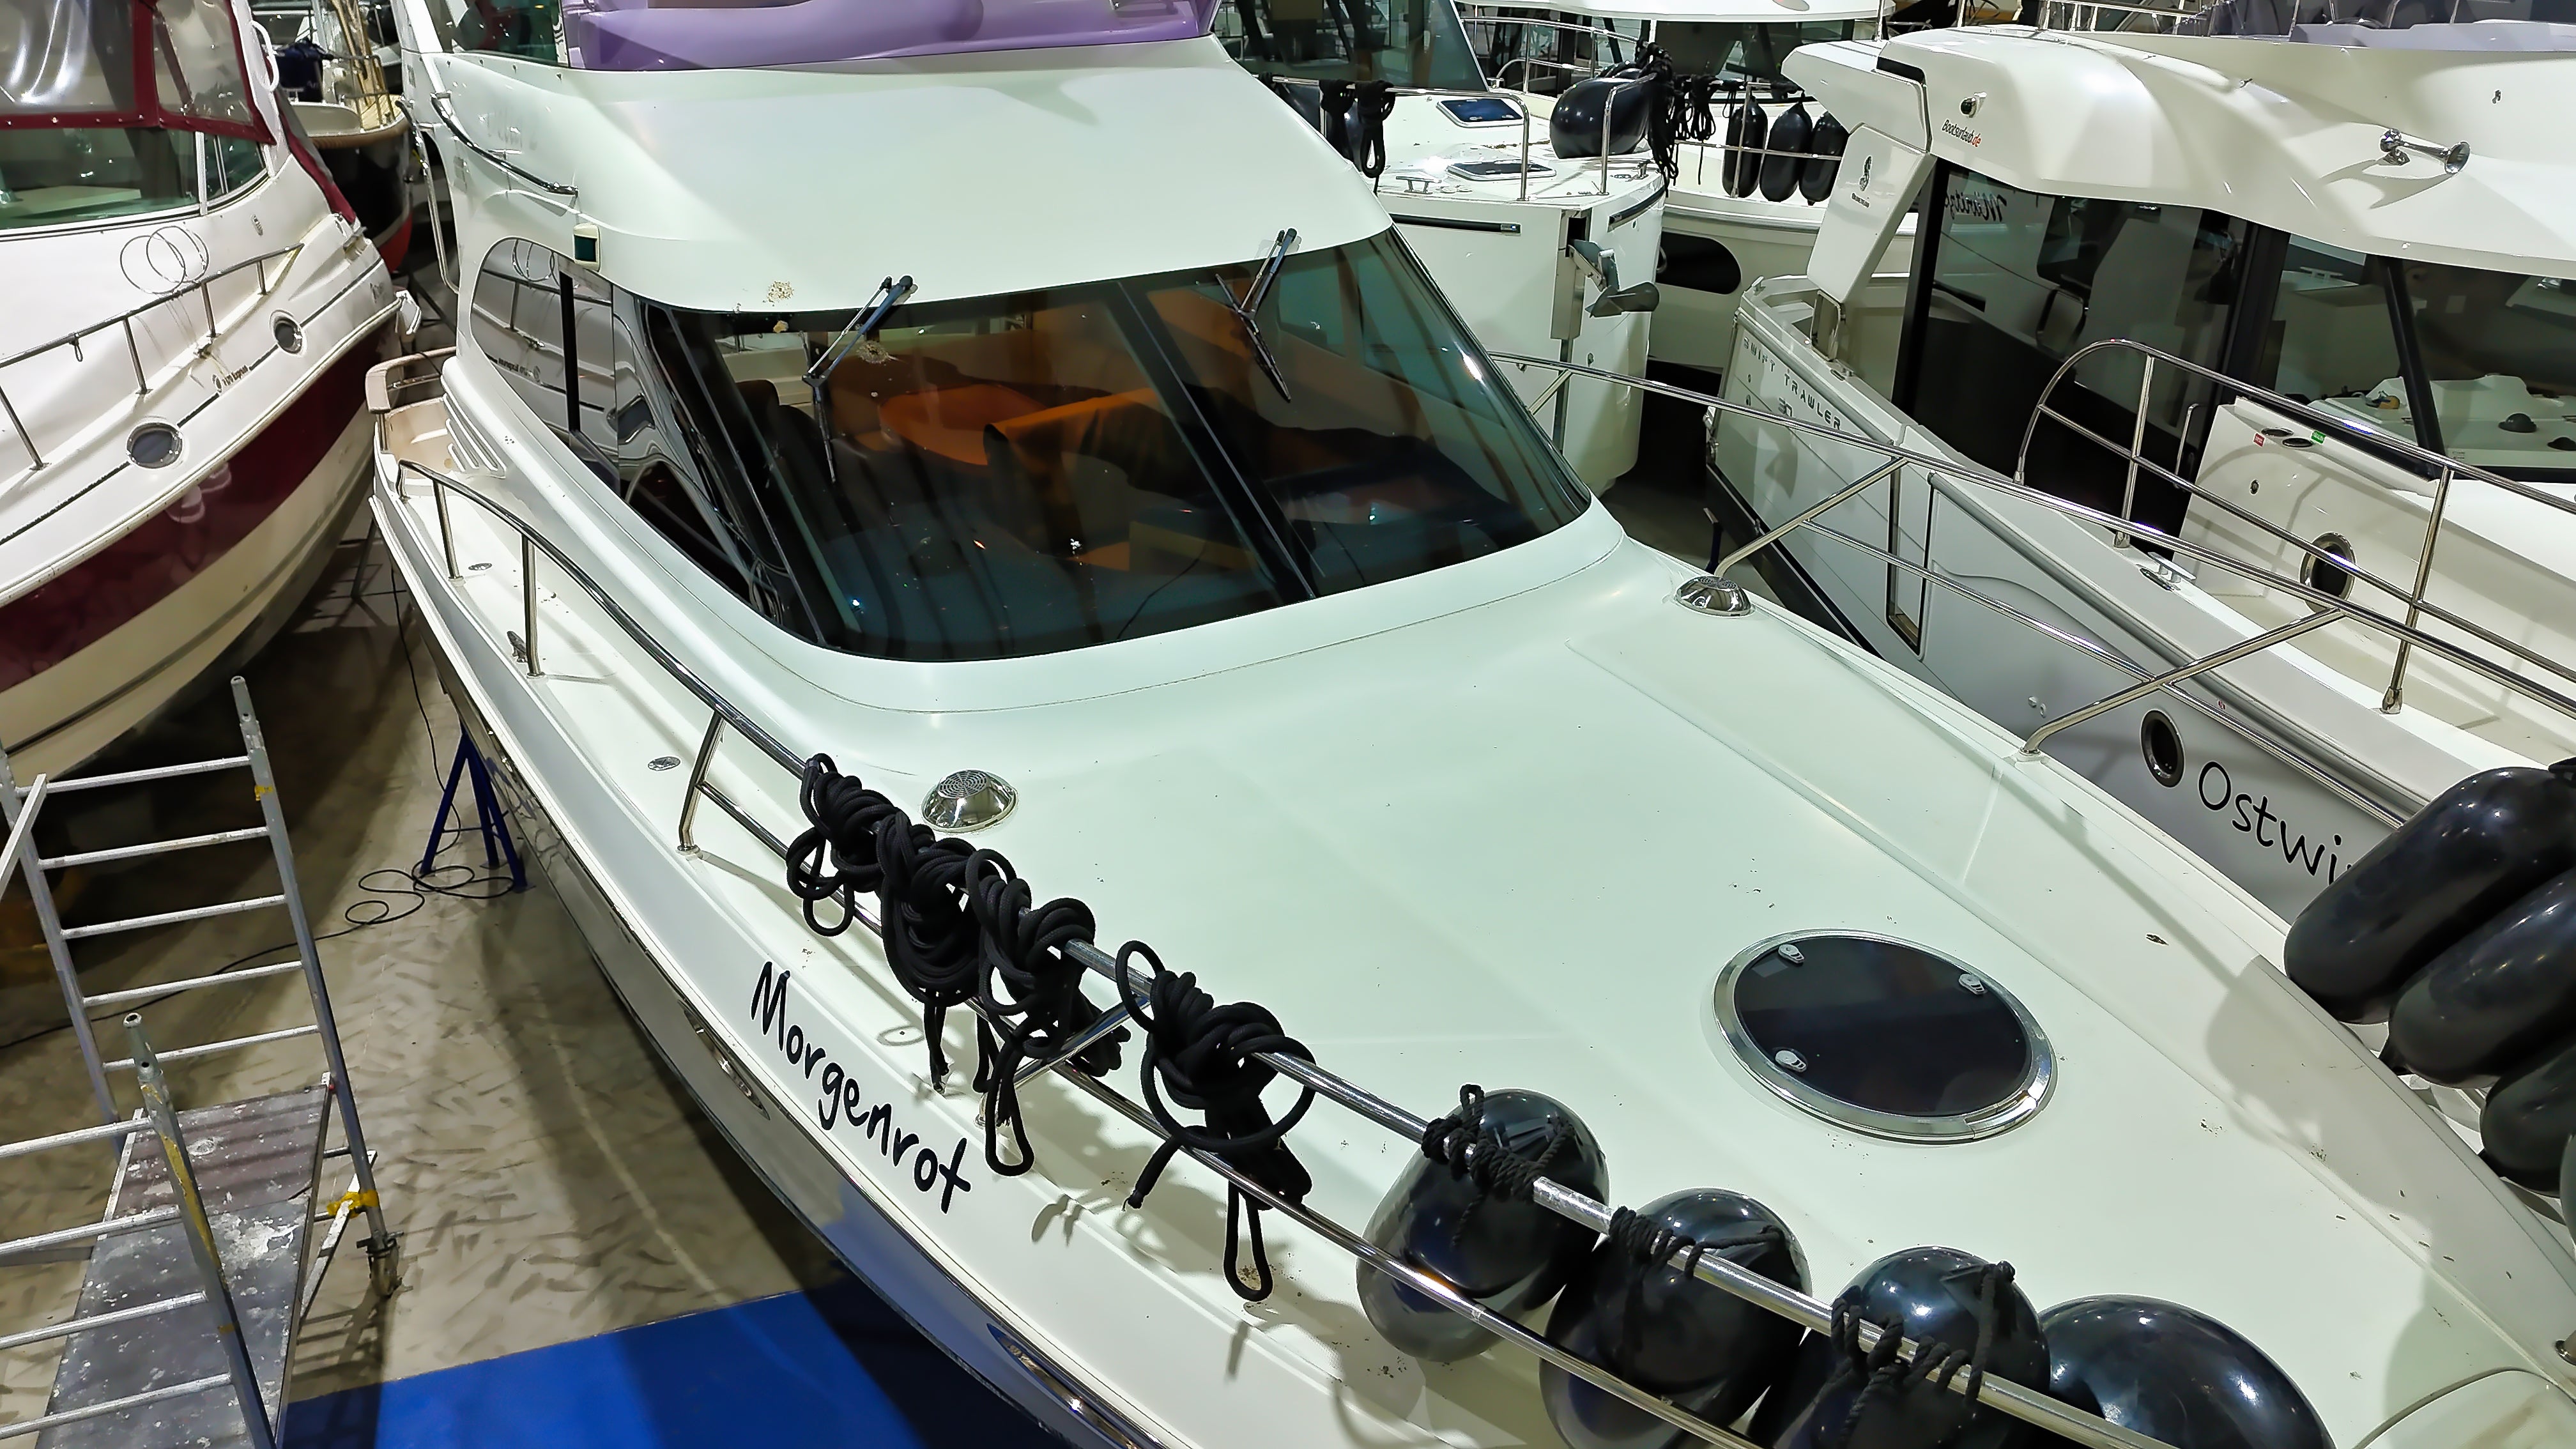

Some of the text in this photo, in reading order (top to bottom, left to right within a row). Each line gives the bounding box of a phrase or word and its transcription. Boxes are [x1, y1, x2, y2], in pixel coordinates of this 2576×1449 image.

[1744, 336, 1841, 430] SWIFT TRAWLER
[2198, 761, 2352, 885] Ostwi
[751, 961, 972, 1215] Morgenrot
